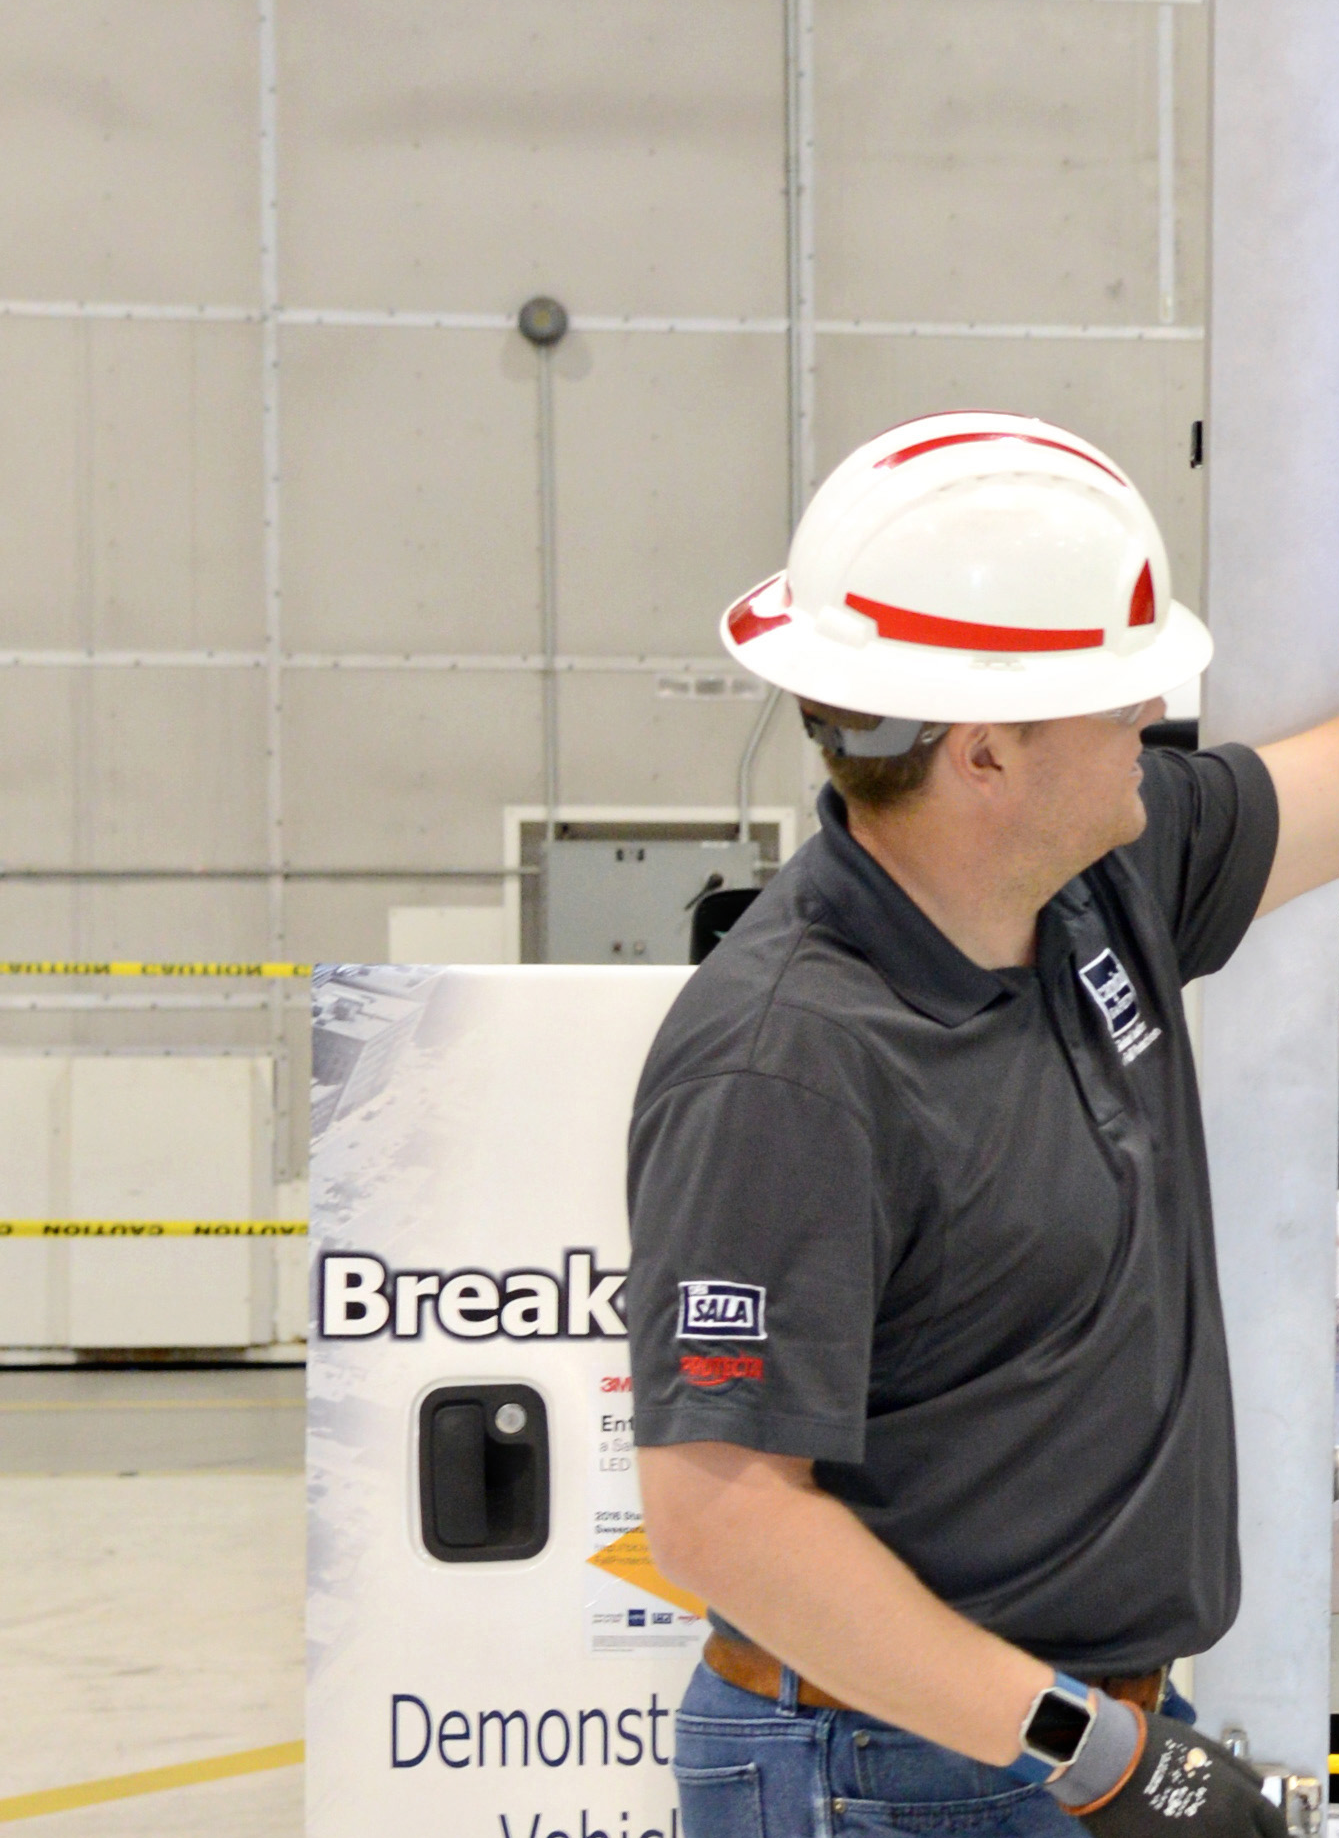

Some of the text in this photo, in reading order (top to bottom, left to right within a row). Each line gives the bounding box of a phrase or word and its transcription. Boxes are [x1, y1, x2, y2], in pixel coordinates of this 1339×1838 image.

[323, 1253, 628, 1336] Break
[694, 1299, 747, 1322] SALA
[602, 1415, 634, 1432] Ent
[392, 1694, 669, 1769] Demonst
